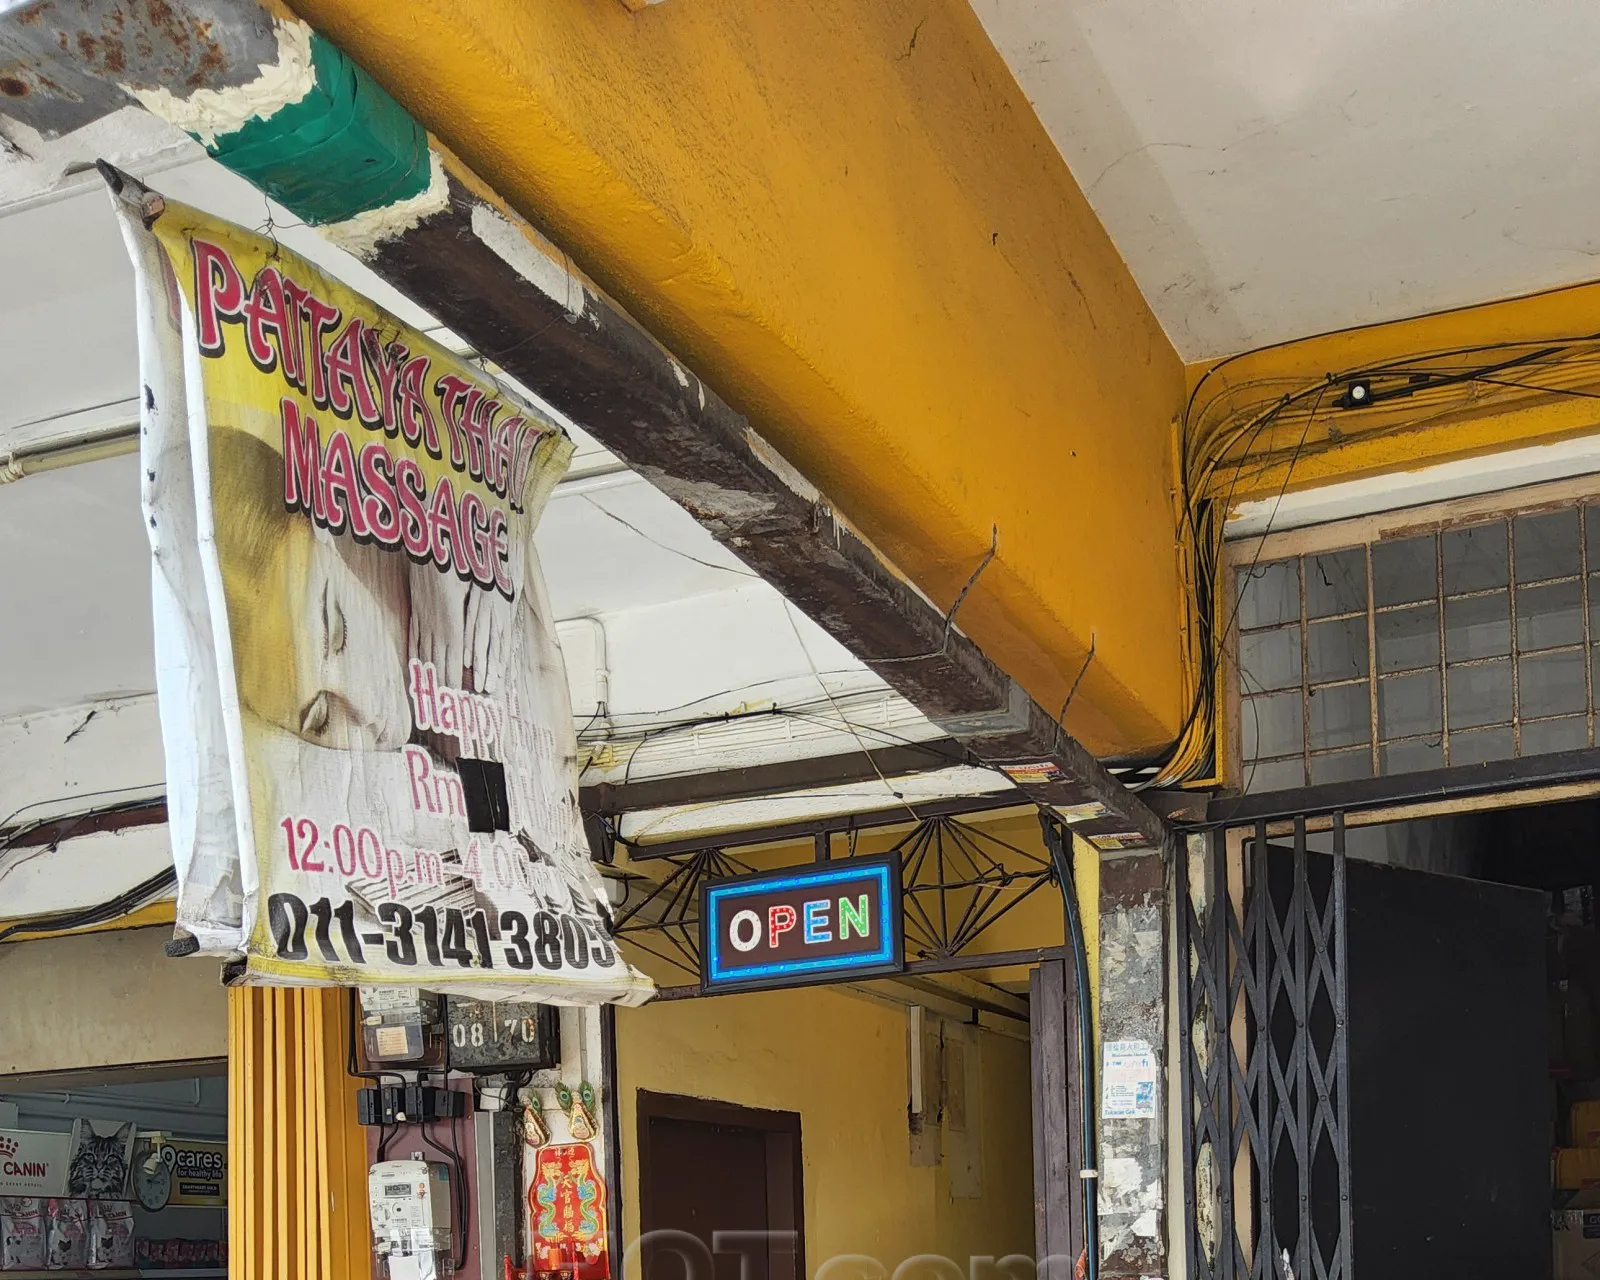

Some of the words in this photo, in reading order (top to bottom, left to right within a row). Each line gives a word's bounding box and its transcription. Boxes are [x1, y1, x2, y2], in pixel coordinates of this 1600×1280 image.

[191, 239, 442, 459] PATTAYA
[435, 374, 543, 515] THAI
[280, 396, 516, 602] MASSAGE
[411, 662, 503, 759] Happy
[729, 894, 870, 951] OPEN
[4, 1161, 46, 1178] CANIN
[176, 1150, 222, 1169] cares
[177, 1168, 187, 1176] for
[188, 1169, 211, 1180] healthy
[212, 1170, 222, 1178] life
